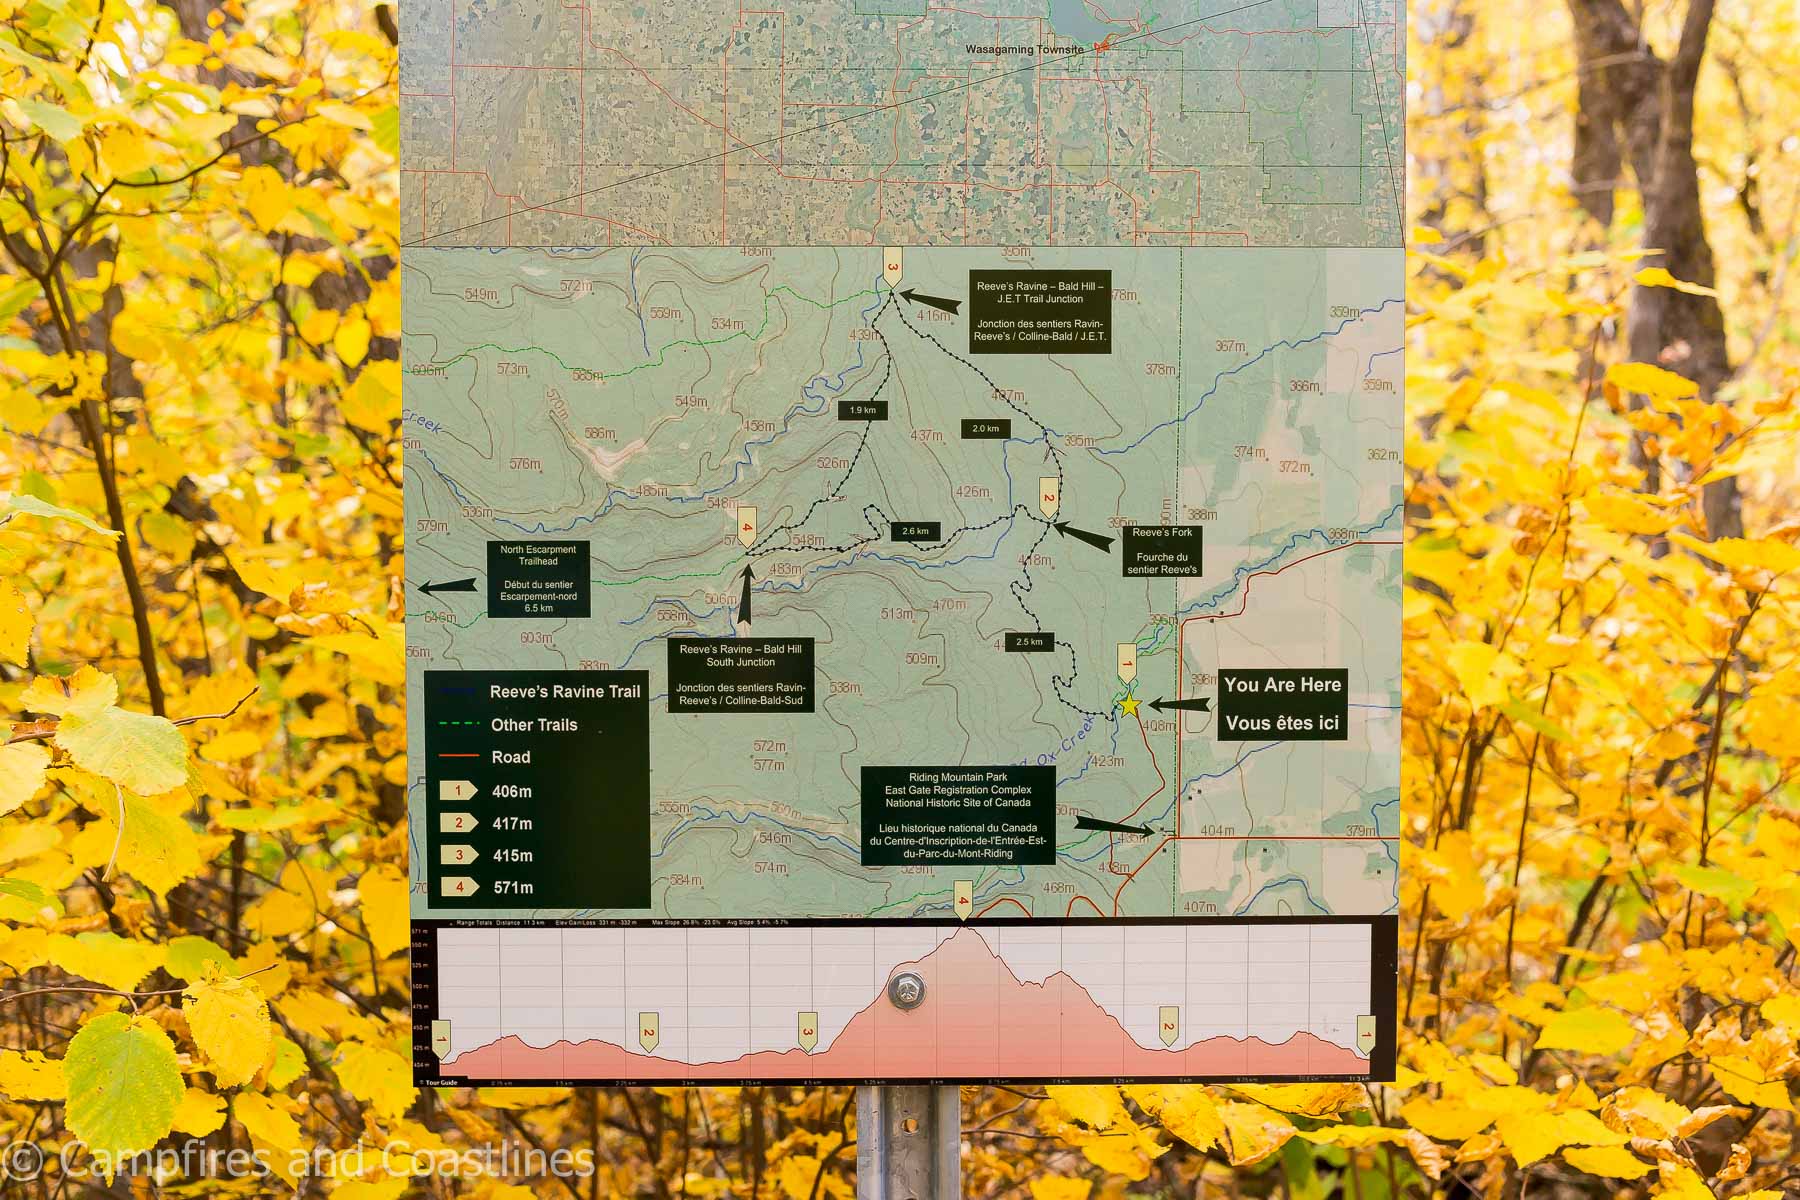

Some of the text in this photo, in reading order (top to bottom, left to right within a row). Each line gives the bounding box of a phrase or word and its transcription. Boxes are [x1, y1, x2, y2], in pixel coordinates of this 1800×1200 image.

[966, 44, 1084, 56] Wasagaming Townsite
[560, 280, 593, 292] 572m
[977, 281, 1095, 291] Reeve's Ravine Bald Hill
[464, 288, 498, 300] 549m
[997, 294, 1083, 303] J.E.T Trail Junction
[650, 308, 681, 319] 559m
[917, 310, 950, 321] 416m
[1330, 307, 1360, 318] 359m
[712, 318, 744, 329] 534m
[978, 319, 1103, 328] Jonction des sentiers Ravin-
[974, 331, 1106, 341] Reeve's Colline-Bald J.E.T.
[1216, 341, 1245, 352] 367m
[497, 363, 528, 374] 573m
[1145, 364, 1176, 375] 378m
[675, 395, 708, 406] 549m
[743, 420, 775, 431] 458m
[911, 430, 943, 440] 437m
[1064, 435, 1095, 446] 395m
[1234, 446, 1265, 458] 374m
[1368, 449, 1398, 460] 362m
[510, 458, 541, 469] 576m
[816, 457, 849, 468] 526m
[1279, 461, 1310, 472] 372m
[956, 486, 990, 497] 426m
[417, 520, 448, 531] 579m
[743, 523, 752, 531] 4
[1133, 528, 1192, 536] Reeve's Fork
[792, 534, 824, 545] 548m
[501, 545, 576, 555] North Escarpment
[519, 557, 558, 565] Trailhead
[1017, 554, 1051, 565] 418m
[1137, 552, 1188, 562] Fourche du
[770, 563, 801, 574] 483m
[1128, 565, 1197, 574] sentier Reeve's
[504, 580, 573, 589] Début du sentier
[500, 592, 577, 602] Escarpement-nord
[524, 604, 553, 612] 6.5 km
[933, 598, 966, 610] 470m
[881, 608, 913, 619] 513m
[520, 632, 552, 644] 603m
[680, 644, 802, 654] Reeve's Ravine Bald Hill
[707, 658, 775, 666] South Junction
[906, 653, 937, 664] 509m
[676, 683, 806, 692] Jonction des sentiers Ravin-
[1224, 677, 1341, 692] You Are Here
[491, 685, 640, 698] Reeve's Ravine Trail
[680, 696, 802, 704] Reeve's Colline-Bald-Sud
[491, 718, 578, 732] Other Trails
[1226, 715, 1338, 730] Vous êtes ici
[1062, 714, 1094, 752] Creek
[754, 740, 785, 751] 572m
[492, 750, 530, 764] Road
[1091, 756, 1124, 767] 423m
[754, 759, 785, 770] 577m
[910, 772, 1008, 784] Riding Mountain Park
[456, 785, 461, 795] 1
[492, 785, 532, 798] 406m
[886, 785, 1032, 796] East Gate Registration Complex
[886, 798, 1031, 807] National Historic Site of Canada
[455, 818, 463, 827] 2
[493, 817, 532, 830] 417m
[880, 823, 1037, 834] Lieu historique national du Canada
[1200, 825, 1235, 836] 404m
[1346, 825, 1376, 836] 379m
[759, 832, 791, 843] 546m
[870, 836, 882, 846] du
[456, 850, 463, 860] 3
[493, 849, 532, 862] 415m
[904, 849, 1013, 860] du-Parc-du-Mont-Riding
[754, 862, 787, 873] 574m
[670, 875, 702, 885] 584m
[456, 882, 464, 892] 4
[494, 881, 533, 894] 571m
[1043, 882, 1075, 893] 468m
[1184, 902, 1216, 912] 407m
[803, 1028, 813, 1036] 3
